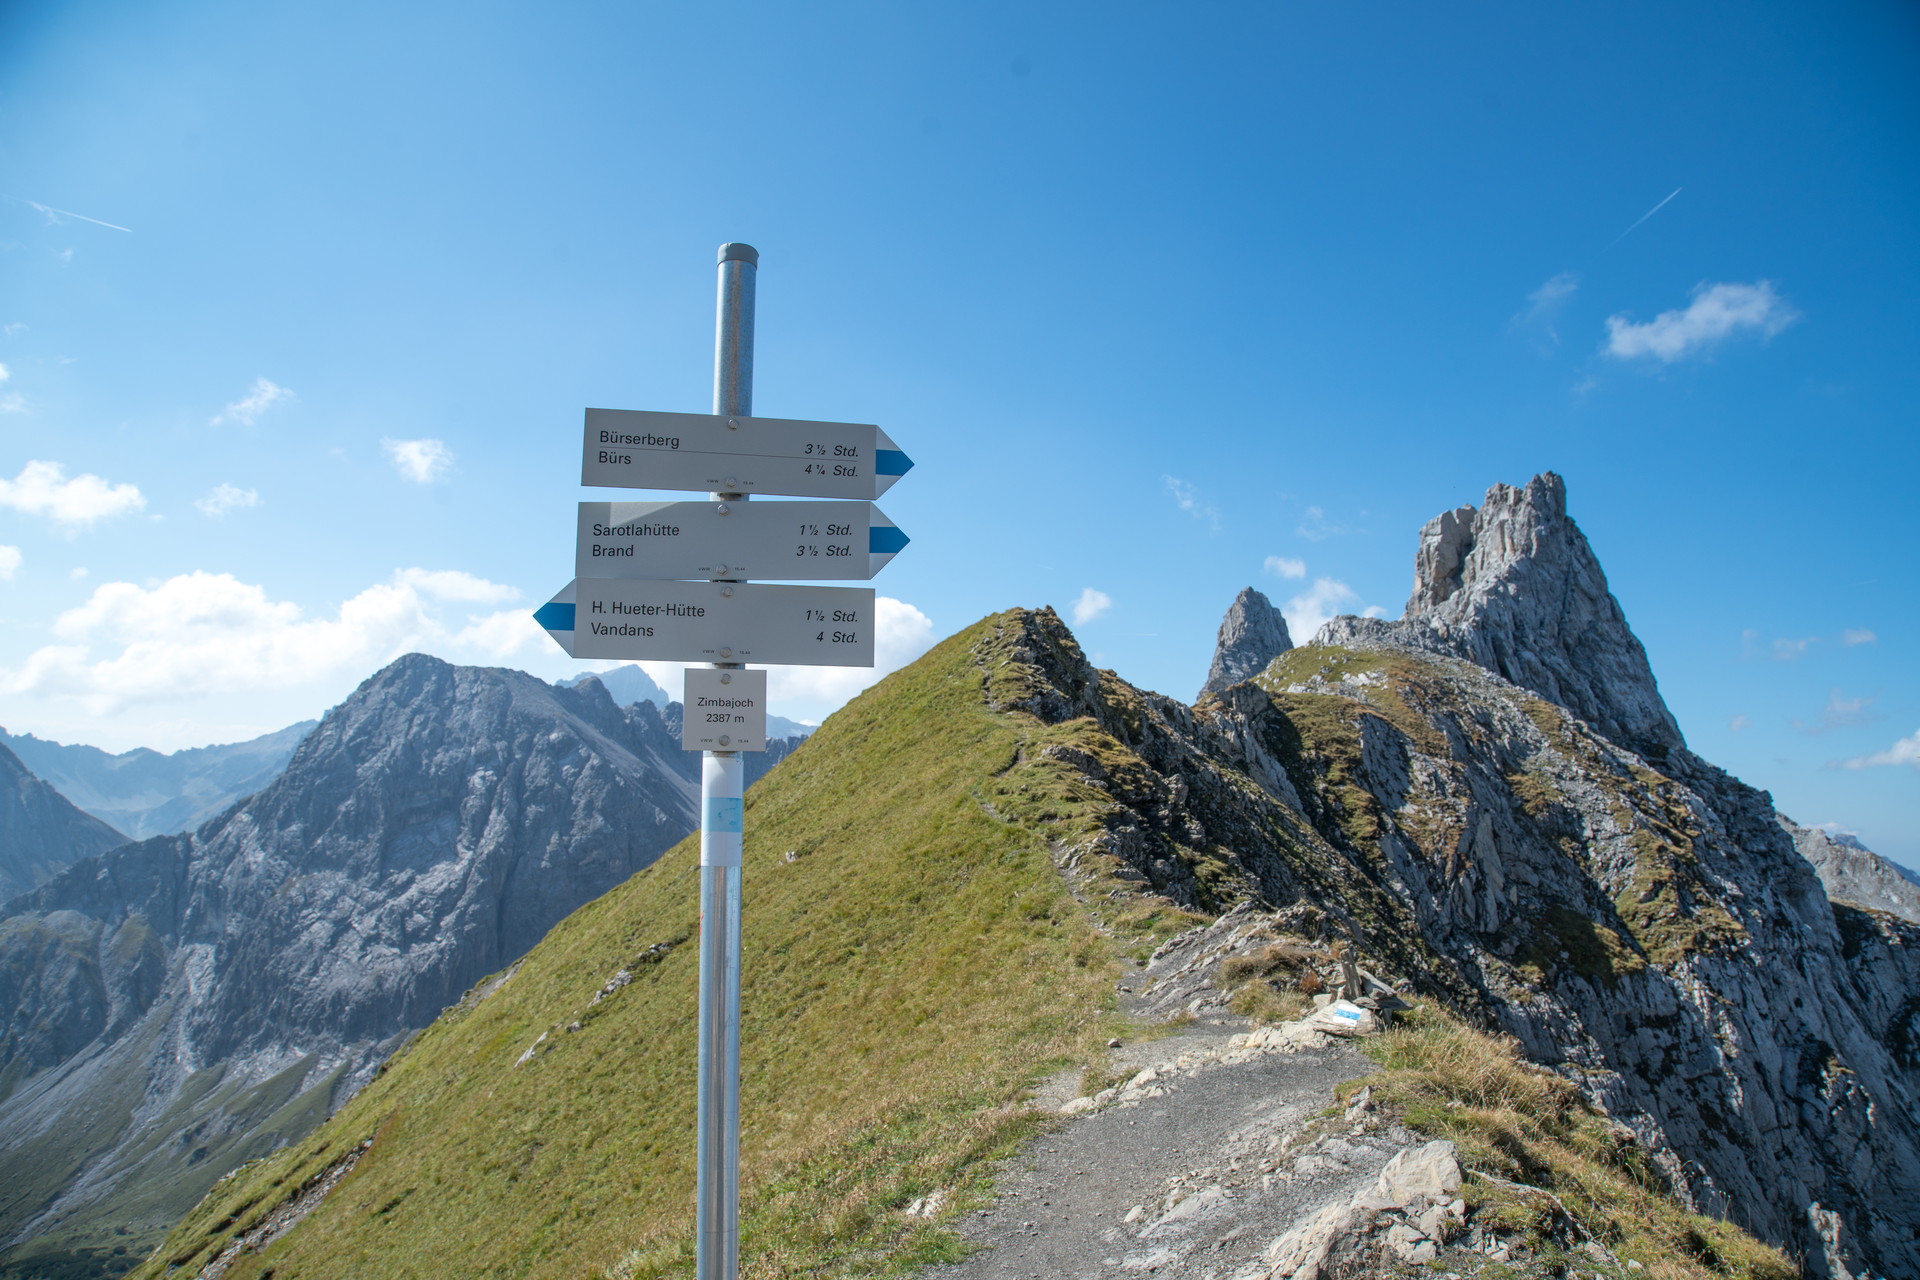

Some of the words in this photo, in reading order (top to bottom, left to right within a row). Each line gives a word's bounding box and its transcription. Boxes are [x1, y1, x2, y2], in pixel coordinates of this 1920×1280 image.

[599, 430, 680, 449] Bürserberg
[834, 444, 859, 457] Std.
[598, 450, 631, 465] Bürs
[833, 465, 858, 477] Std.
[593, 524, 680, 537] Sarotlahütte
[826, 524, 852, 536] Std.
[592, 544, 634, 557] Brand
[826, 545, 852, 557] Std.
[592, 601, 606, 614] H.
[612, 602, 705, 617] Hueter-Hütte
[832, 610, 858, 623] Std.
[591, 623, 654, 637] Vandans
[816, 631, 824, 643] 4
[831, 631, 858, 644] Std.
[697, 697, 754, 709] Zimbajoch
[706, 714, 731, 722] 2387
